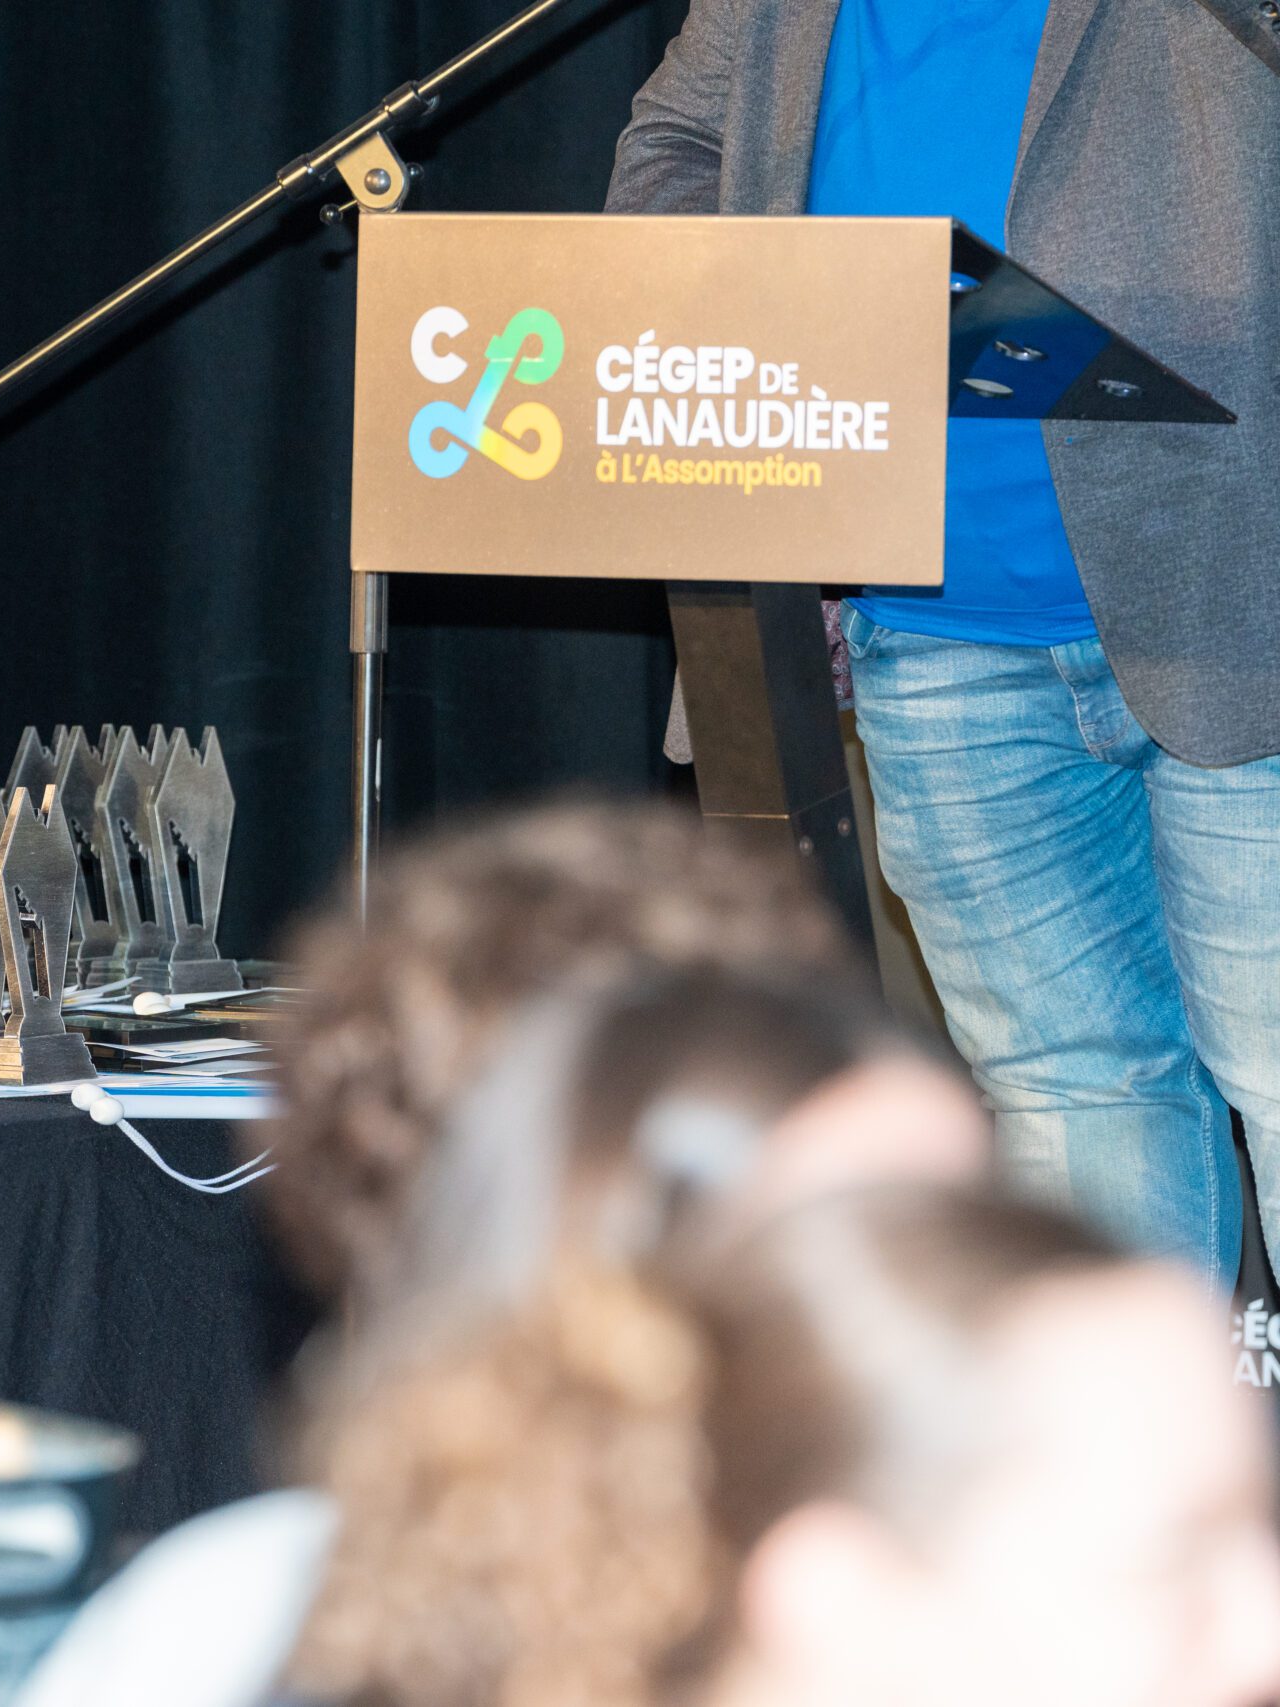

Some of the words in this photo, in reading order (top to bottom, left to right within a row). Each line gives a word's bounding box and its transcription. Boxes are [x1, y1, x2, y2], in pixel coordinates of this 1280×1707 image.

[595, 328, 755, 394] CÉGEP
[759, 362, 800, 395] DE
[595, 384, 890, 451] LANAUDIÈRE
[595, 449, 618, 483] à
